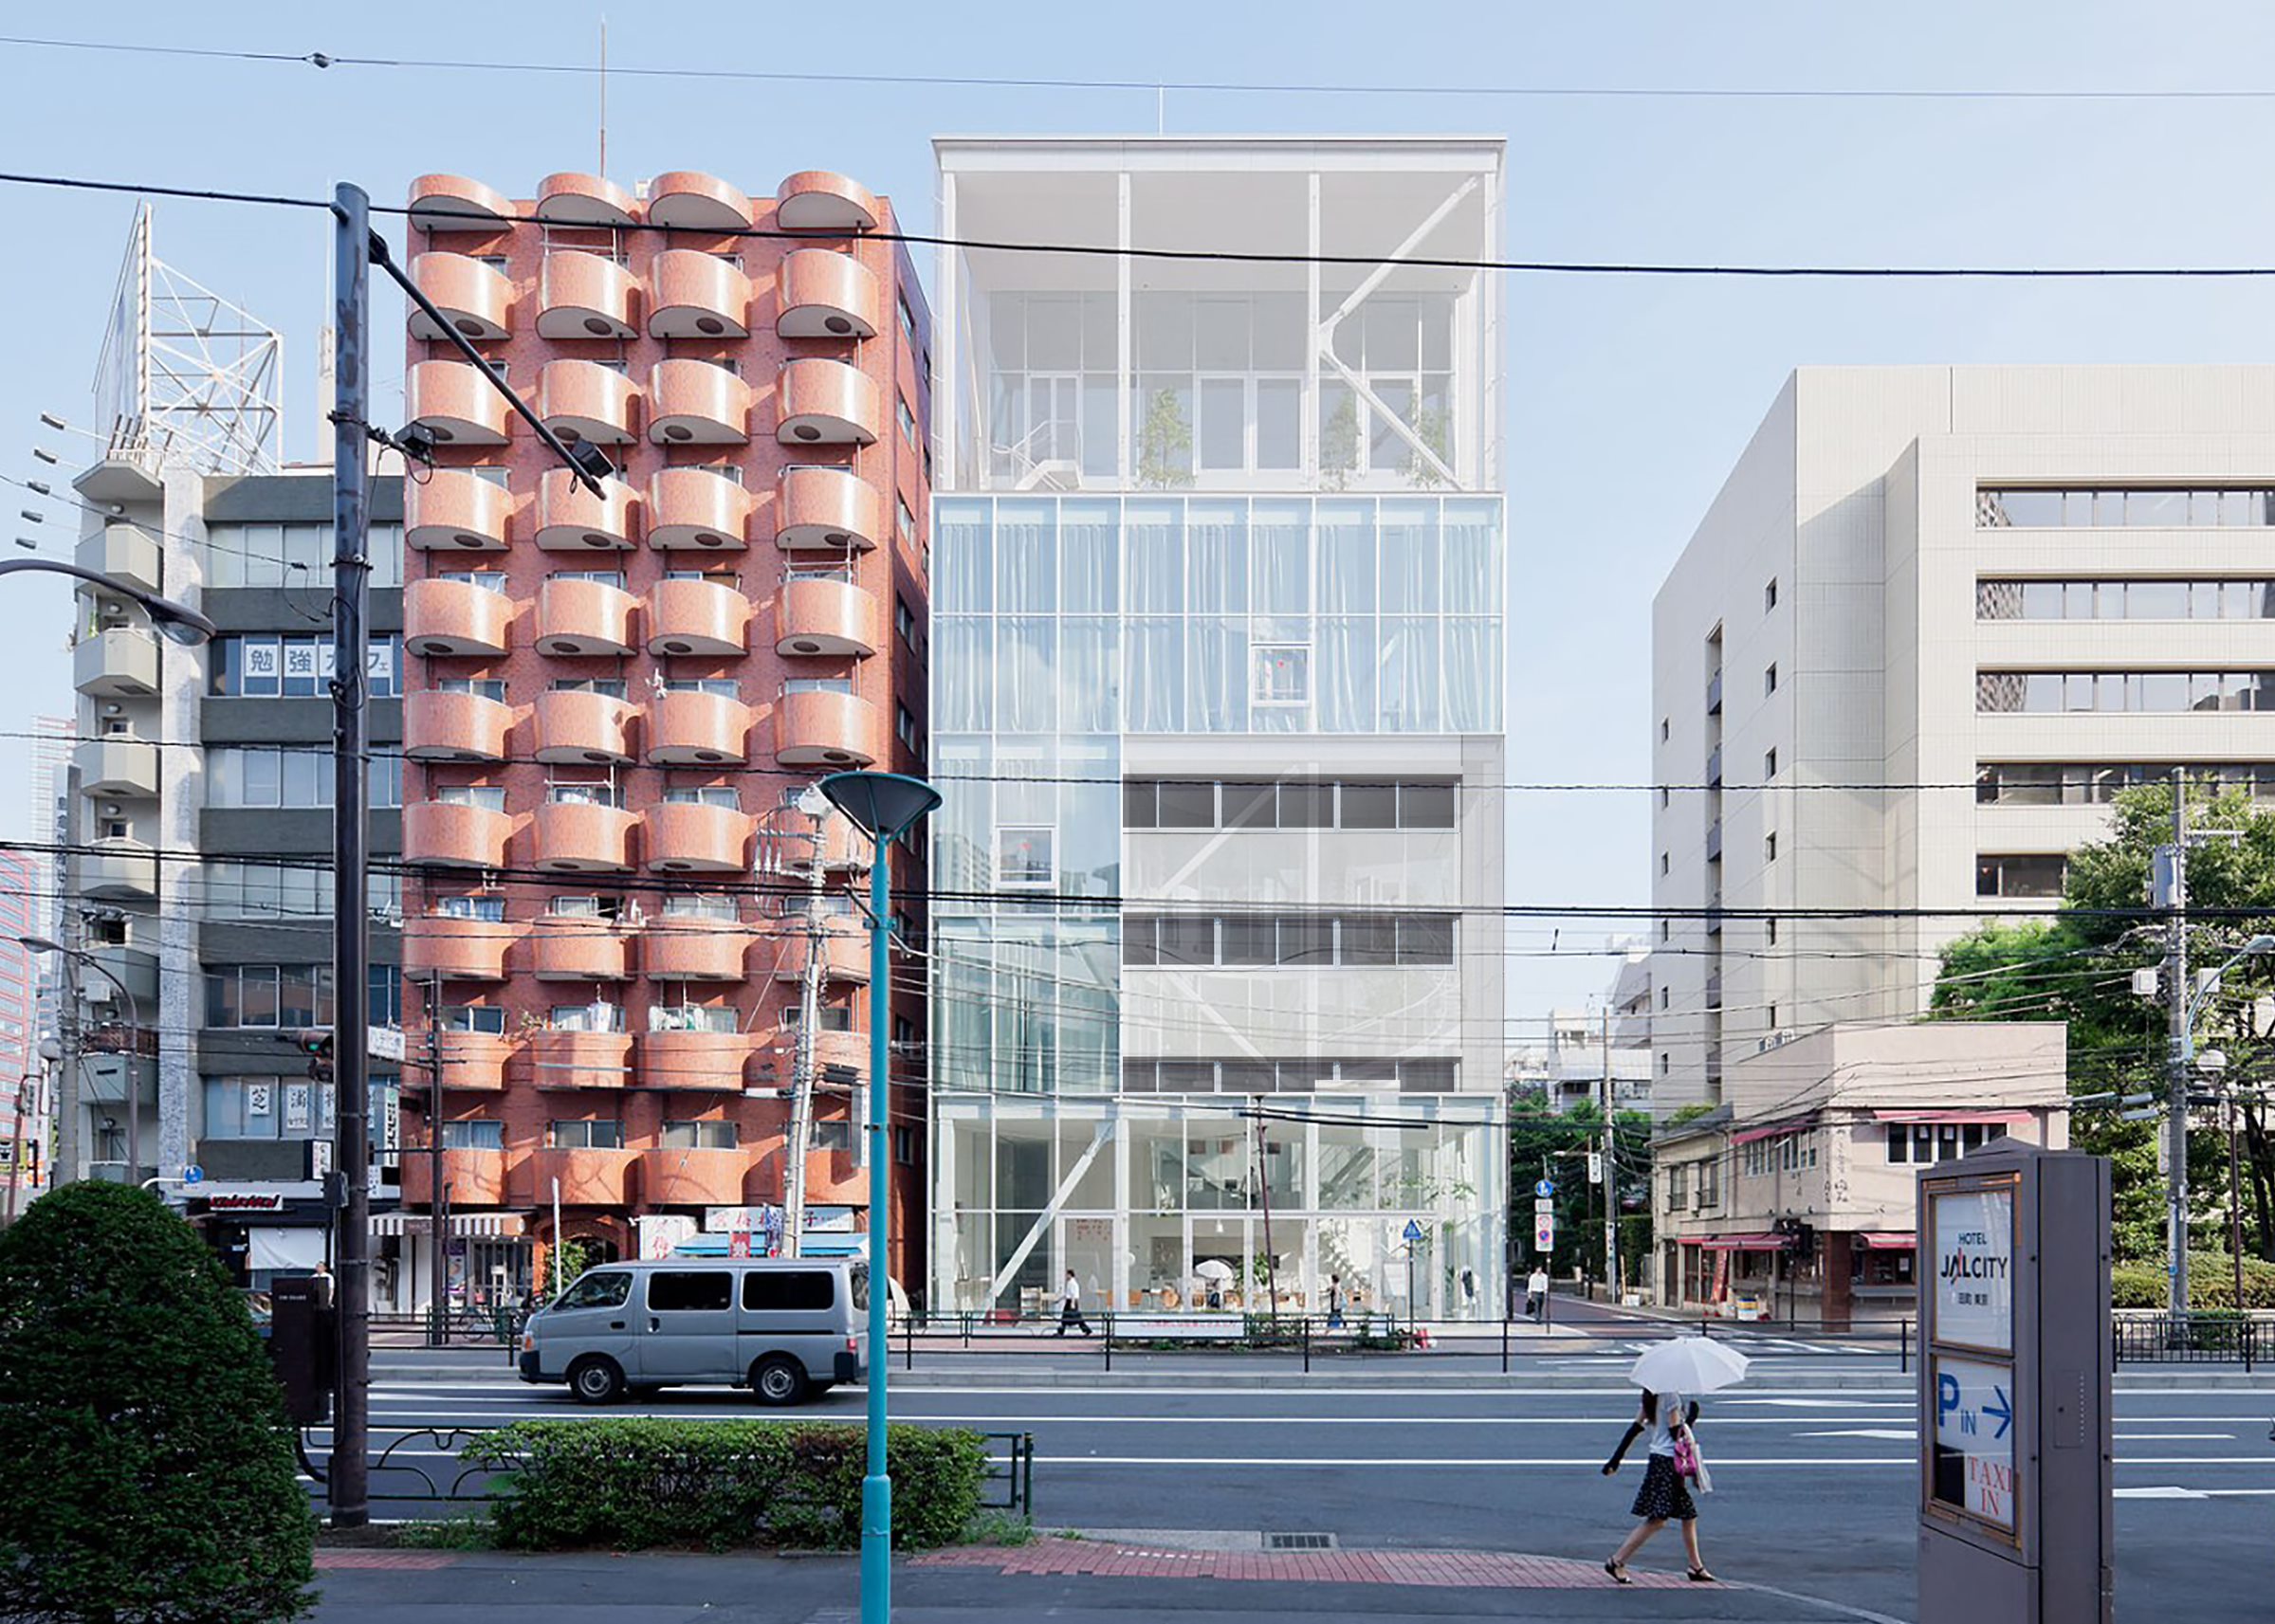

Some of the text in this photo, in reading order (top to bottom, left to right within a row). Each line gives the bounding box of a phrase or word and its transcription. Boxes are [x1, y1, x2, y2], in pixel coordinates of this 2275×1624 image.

[1958, 1232, 1988, 1245] HOTEL
[1940, 1248, 2008, 1283] JALCITY
[1938, 1373, 1977, 1436] P IN
[1969, 1456, 2012, 1493] TAXI
[1982, 1487, 2000, 1516] IN
